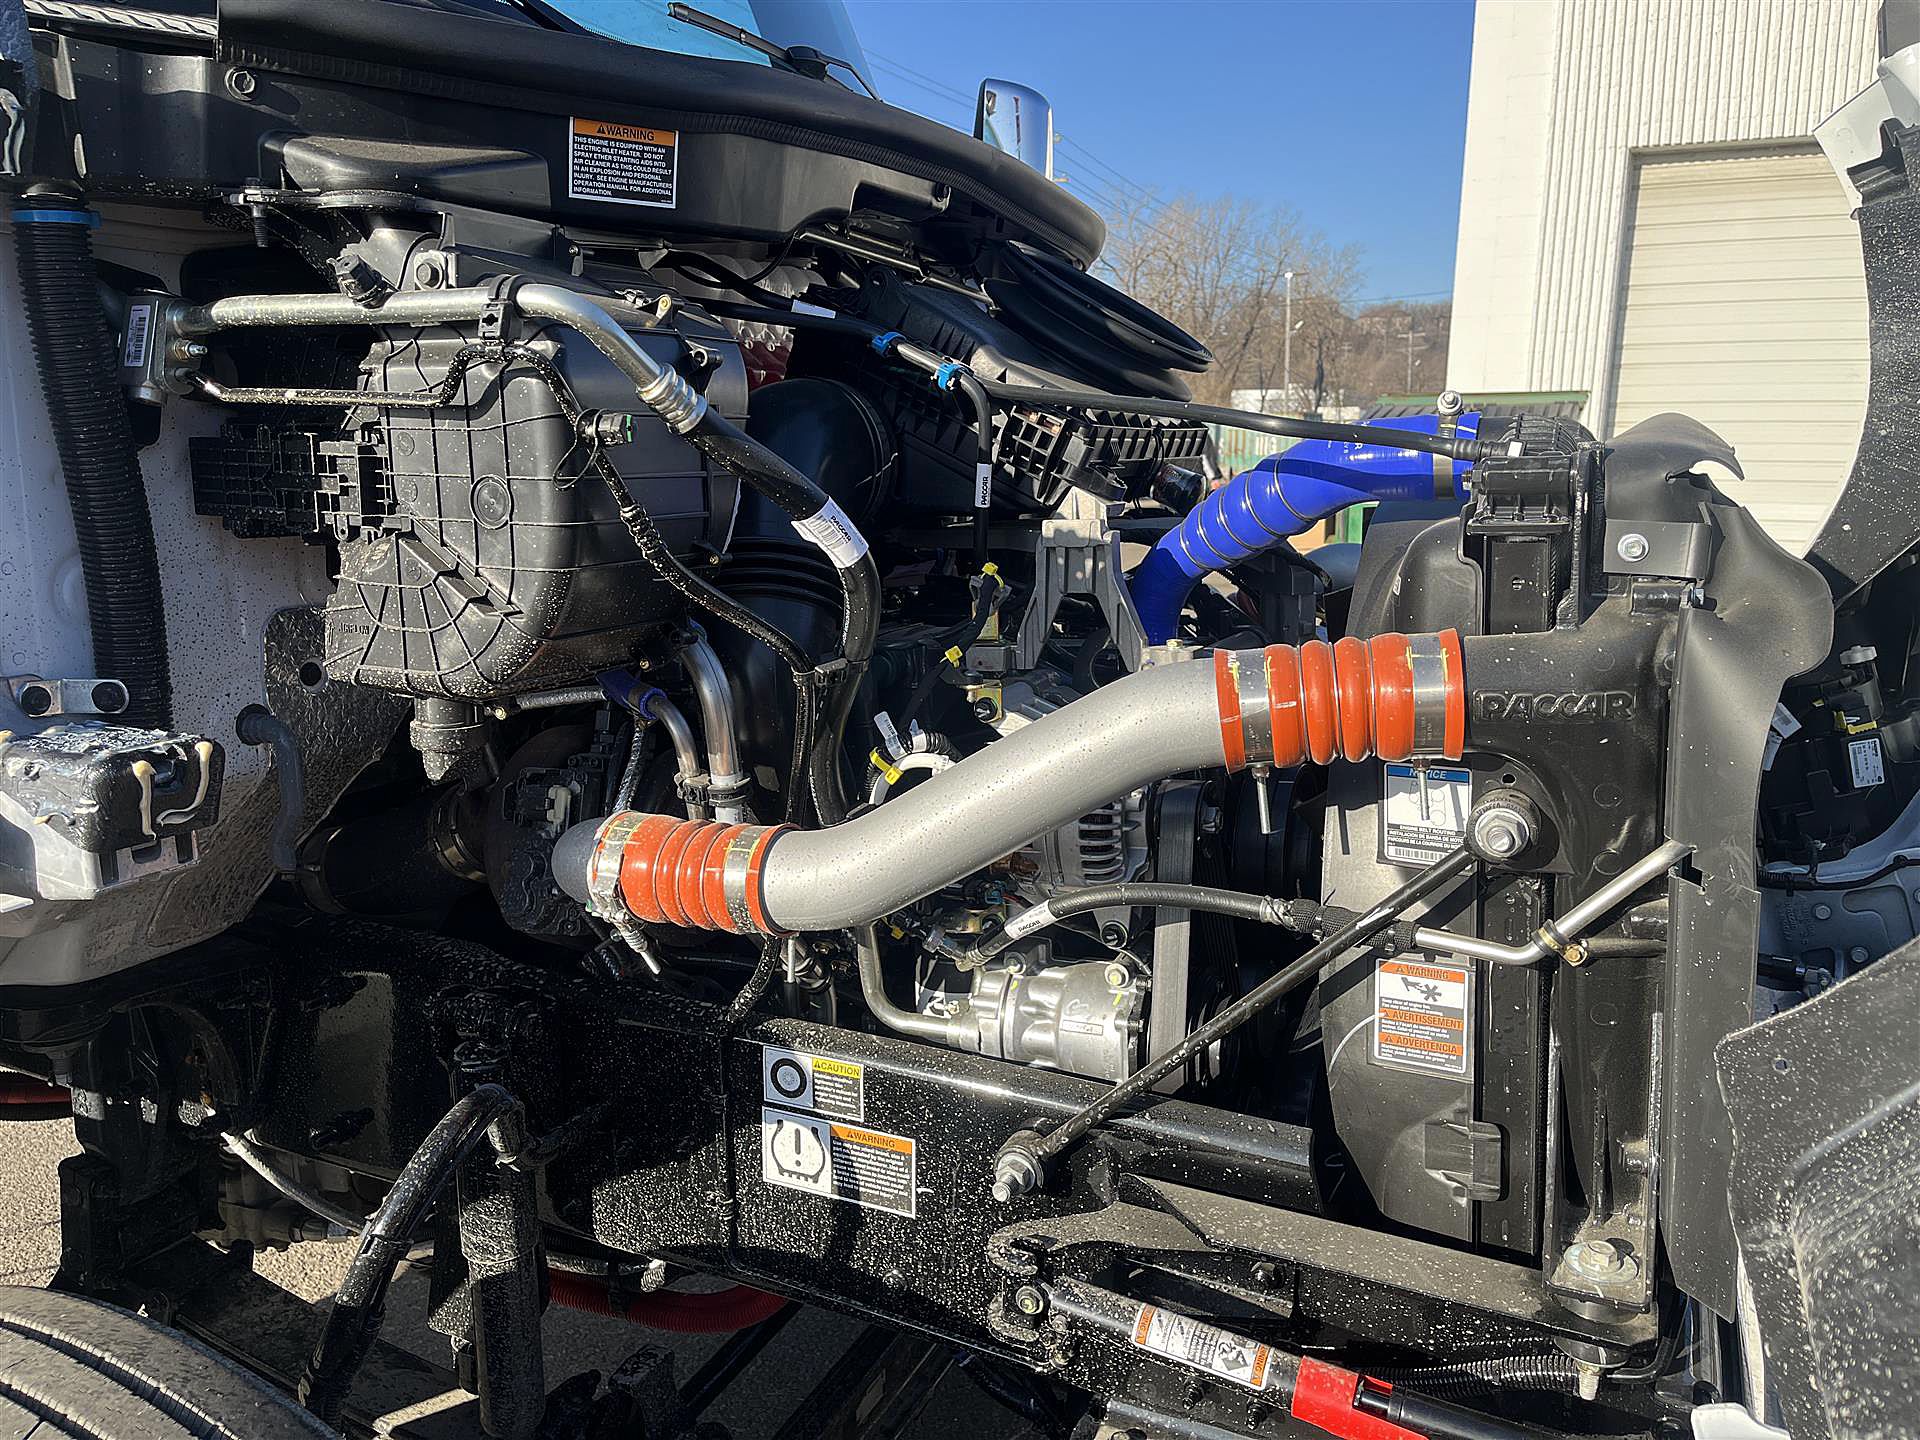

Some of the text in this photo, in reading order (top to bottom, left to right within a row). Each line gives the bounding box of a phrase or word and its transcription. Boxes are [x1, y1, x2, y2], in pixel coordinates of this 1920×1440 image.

[606, 125, 655, 141] WARNING
[574, 144, 601, 153] ELECTRIC
[602, 147, 617, 155] INLET
[588, 138, 608, 146] ENGINE
[616, 141, 643, 150] EQUIPPED
[574, 151, 592, 159] SPRAY
[594, 153, 612, 161] ETHER
[613, 156, 639, 164] STARTING
[585, 160, 610, 168] CLEANER
[652, 167, 672, 175] RESULT
[590, 167, 620, 176] EXPLOSION
[634, 172, 661, 180] PERSONAL
[574, 180, 605, 189] OPERATION
[607, 183, 628, 191] MANUAL
[642, 187, 671, 195] ADDITIONAL
[609, 176, 627, 184] ENGINE
[629, 178, 672, 188] MANUFACTURERS
[981, 476, 989, 506] PACCAR
[830, 515, 852, 542] PACCAR
[1477, 690, 1635, 721] PACCAR
[1409, 769, 1447, 779] NTICE
[1018, 920, 1041, 932] PACCAR
[1407, 965, 1449, 979] WARNING
[1393, 1011, 1462, 1029] AVERTISSEMENT
[1397, 1036, 1457, 1053] ADVERTENCIA
[821, 1063, 860, 1076] CAUTION
[854, 1133, 896, 1148] WARNING
